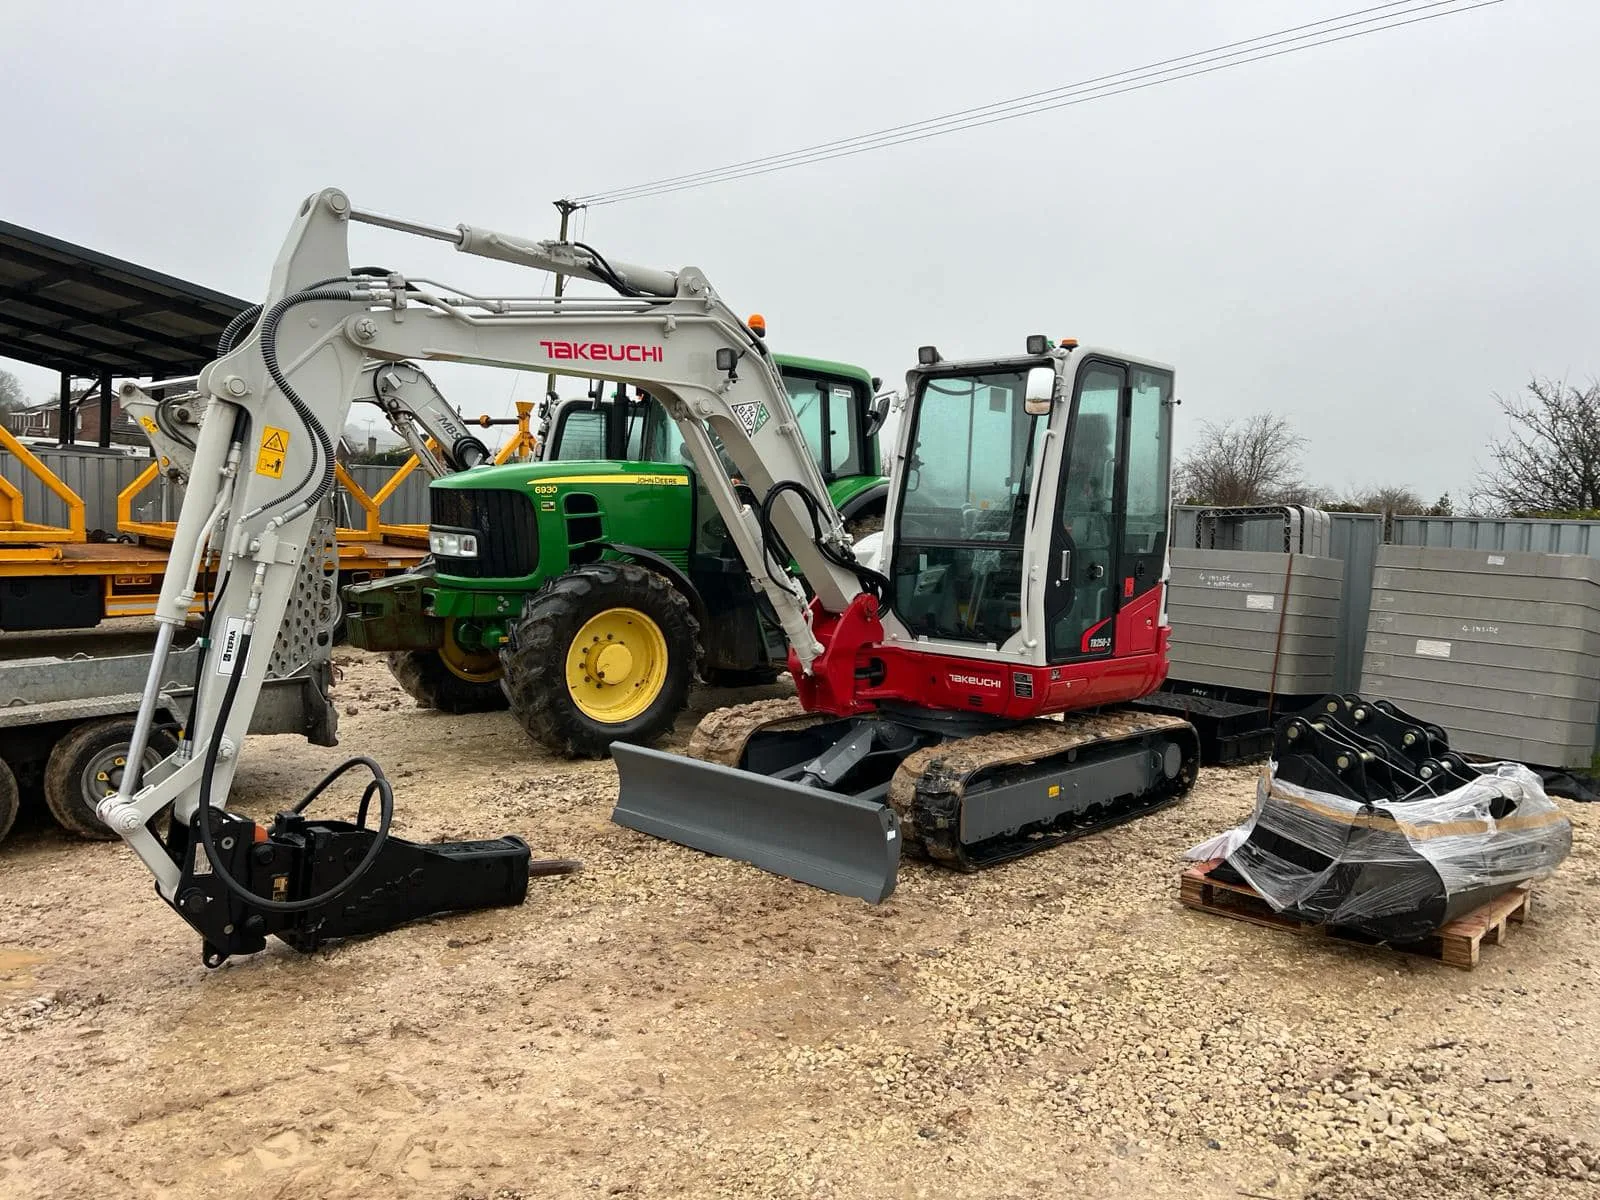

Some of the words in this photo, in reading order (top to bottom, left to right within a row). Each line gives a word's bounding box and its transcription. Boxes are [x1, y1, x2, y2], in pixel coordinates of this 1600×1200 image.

[539, 341, 663, 363] TAKEUCHI
[636, 476, 654, 485] JOHN
[655, 476, 678, 485] DEERE
[534, 486, 558, 494] 6930
[948, 673, 1001, 688] TAKEUCHI
